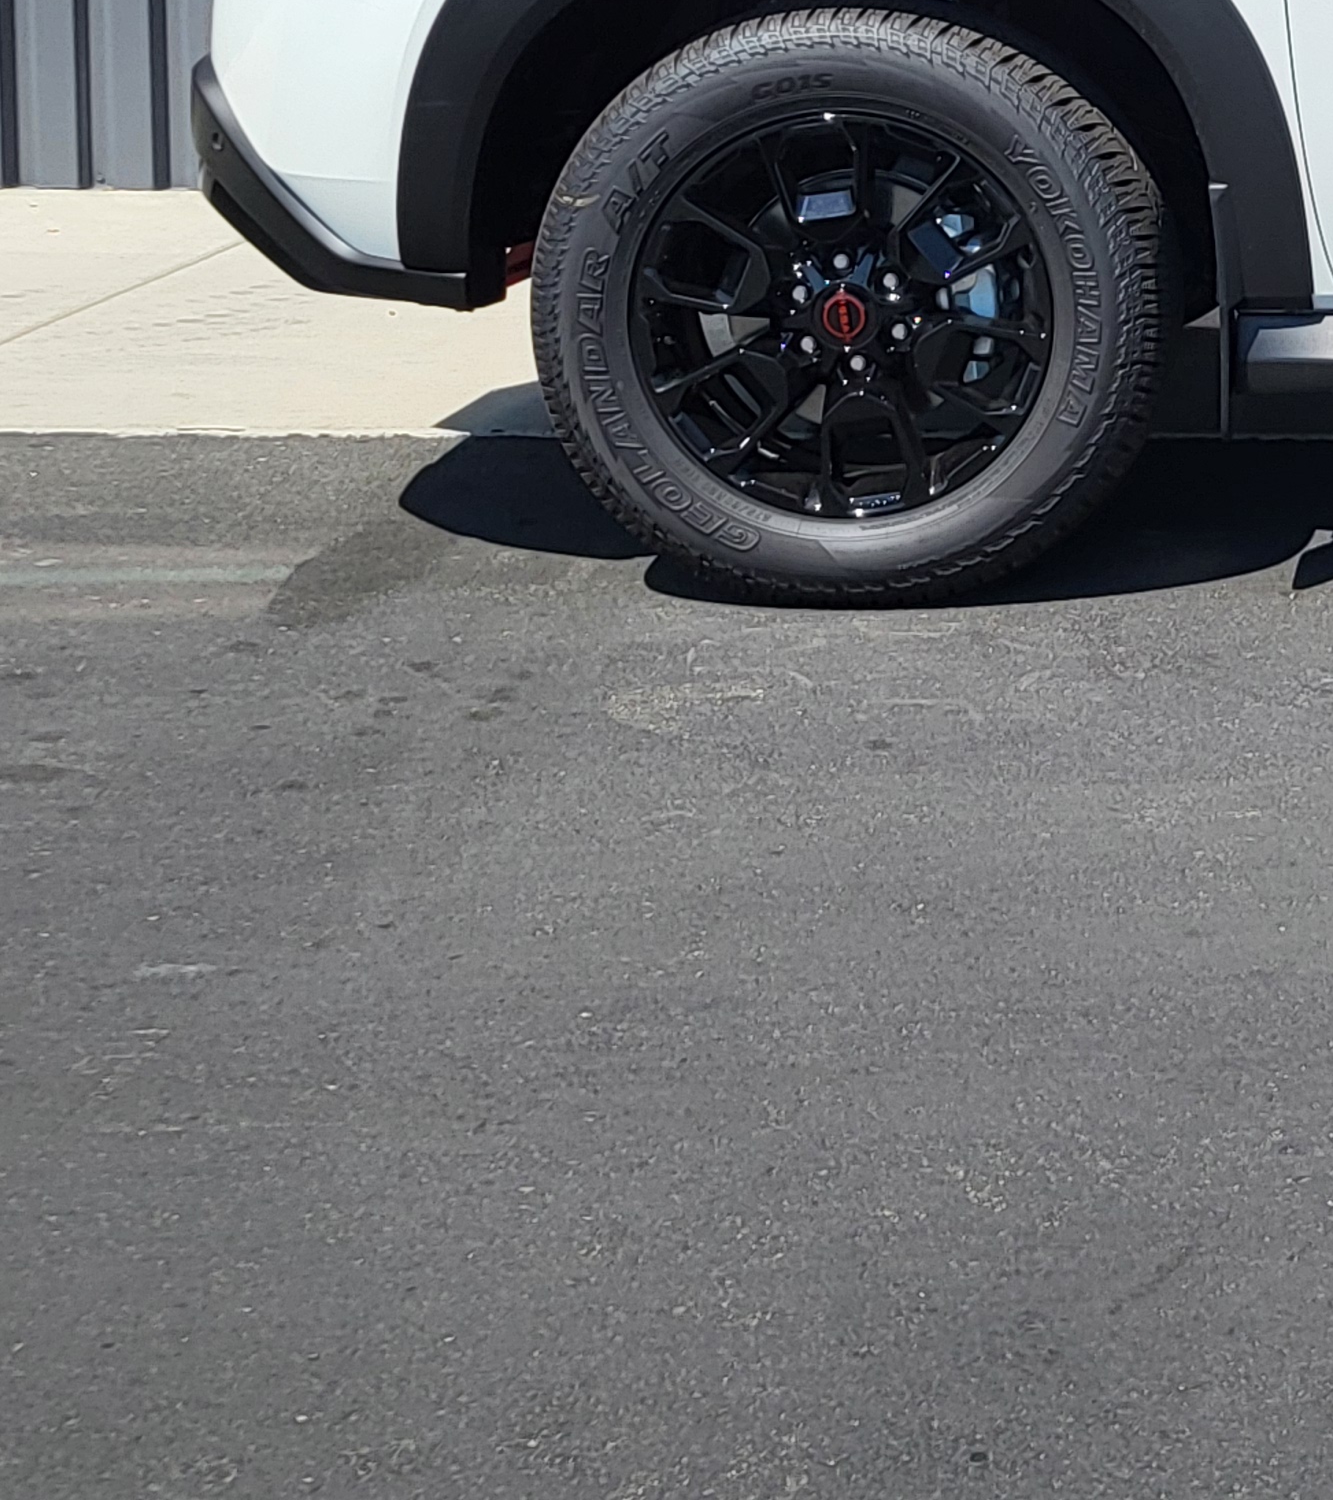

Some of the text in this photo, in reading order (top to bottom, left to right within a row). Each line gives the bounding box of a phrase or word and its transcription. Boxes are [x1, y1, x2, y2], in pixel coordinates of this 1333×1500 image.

[602, 127, 671, 237] A/T
[1003, 133, 1102, 428] YOKOHAMA
[576, 245, 762, 553] GEOLANDAR
